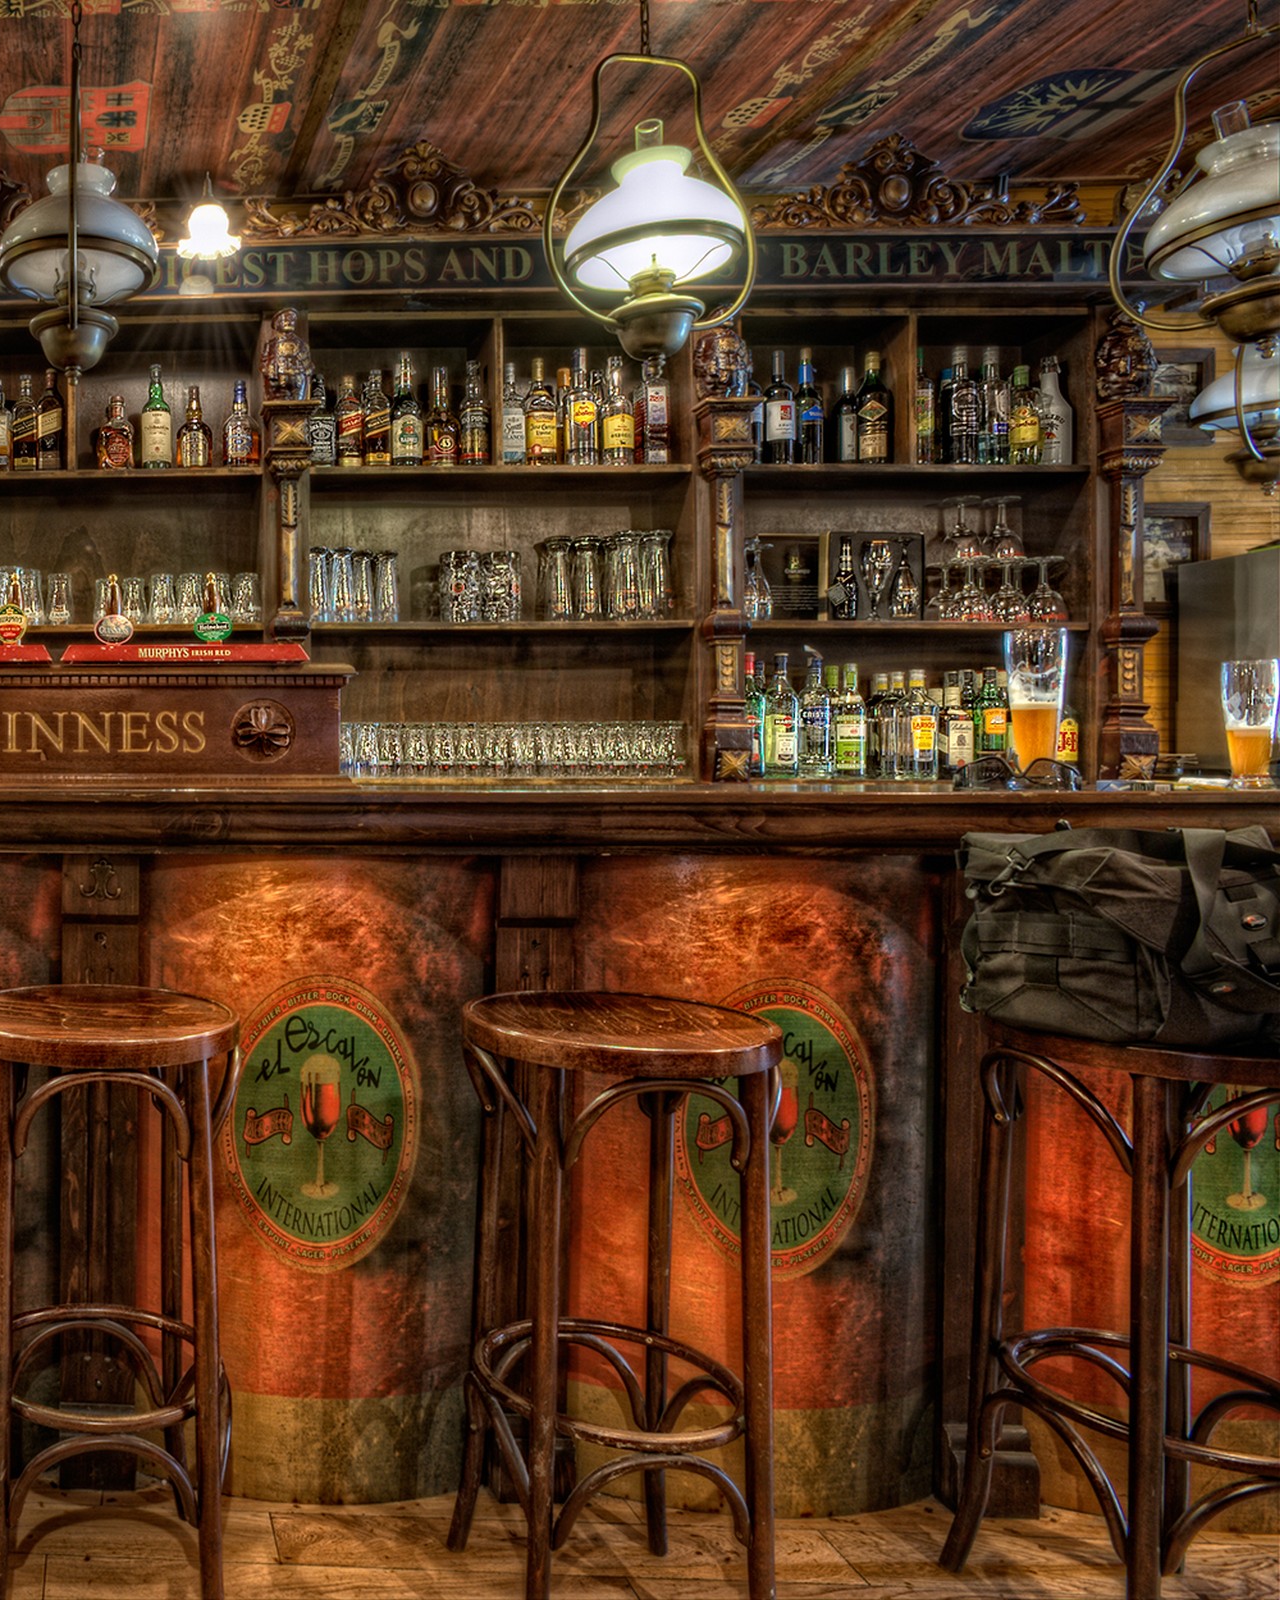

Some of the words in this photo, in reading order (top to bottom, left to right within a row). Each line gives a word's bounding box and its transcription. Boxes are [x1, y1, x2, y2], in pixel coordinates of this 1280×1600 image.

[307, 248, 427, 284] HOPS
[437, 246, 534, 282] AND
[780, 240, 973, 279] BARLEY
[980, 239, 1117, 278] MALT
[198, 622, 229, 632] Heineken
[287, 991, 319, 1007] BITTER
[326, 992, 351, 1006] BOCK
[743, 994, 777, 1010] BITTER
[783, 994, 809, 1008] BOCK
[356, 1002, 379, 1025] DARK
[813, 1004, 837, 1028] DARK
[382, 1026, 407, 1073] DUNKEL
[838, 1033, 863, 1082] DUNKEL
[233, 1172, 255, 1215] STOUT
[256, 1176, 383, 1237] INTERNATIONAL
[684, 1180, 709, 1221] STOUT
[710, 1184, 840, 1246] INTATIONAL
[257, 1219, 291, 1250] EXPORT
[331, 1229, 372, 1257] PILSENER
[711, 1226, 741, 1255] EXPOR
[295, 1247, 326, 1260] LAGER
[789, 1236, 830, 1265] PILSENER
[1222, 1258, 1253, 1273] LAGER
